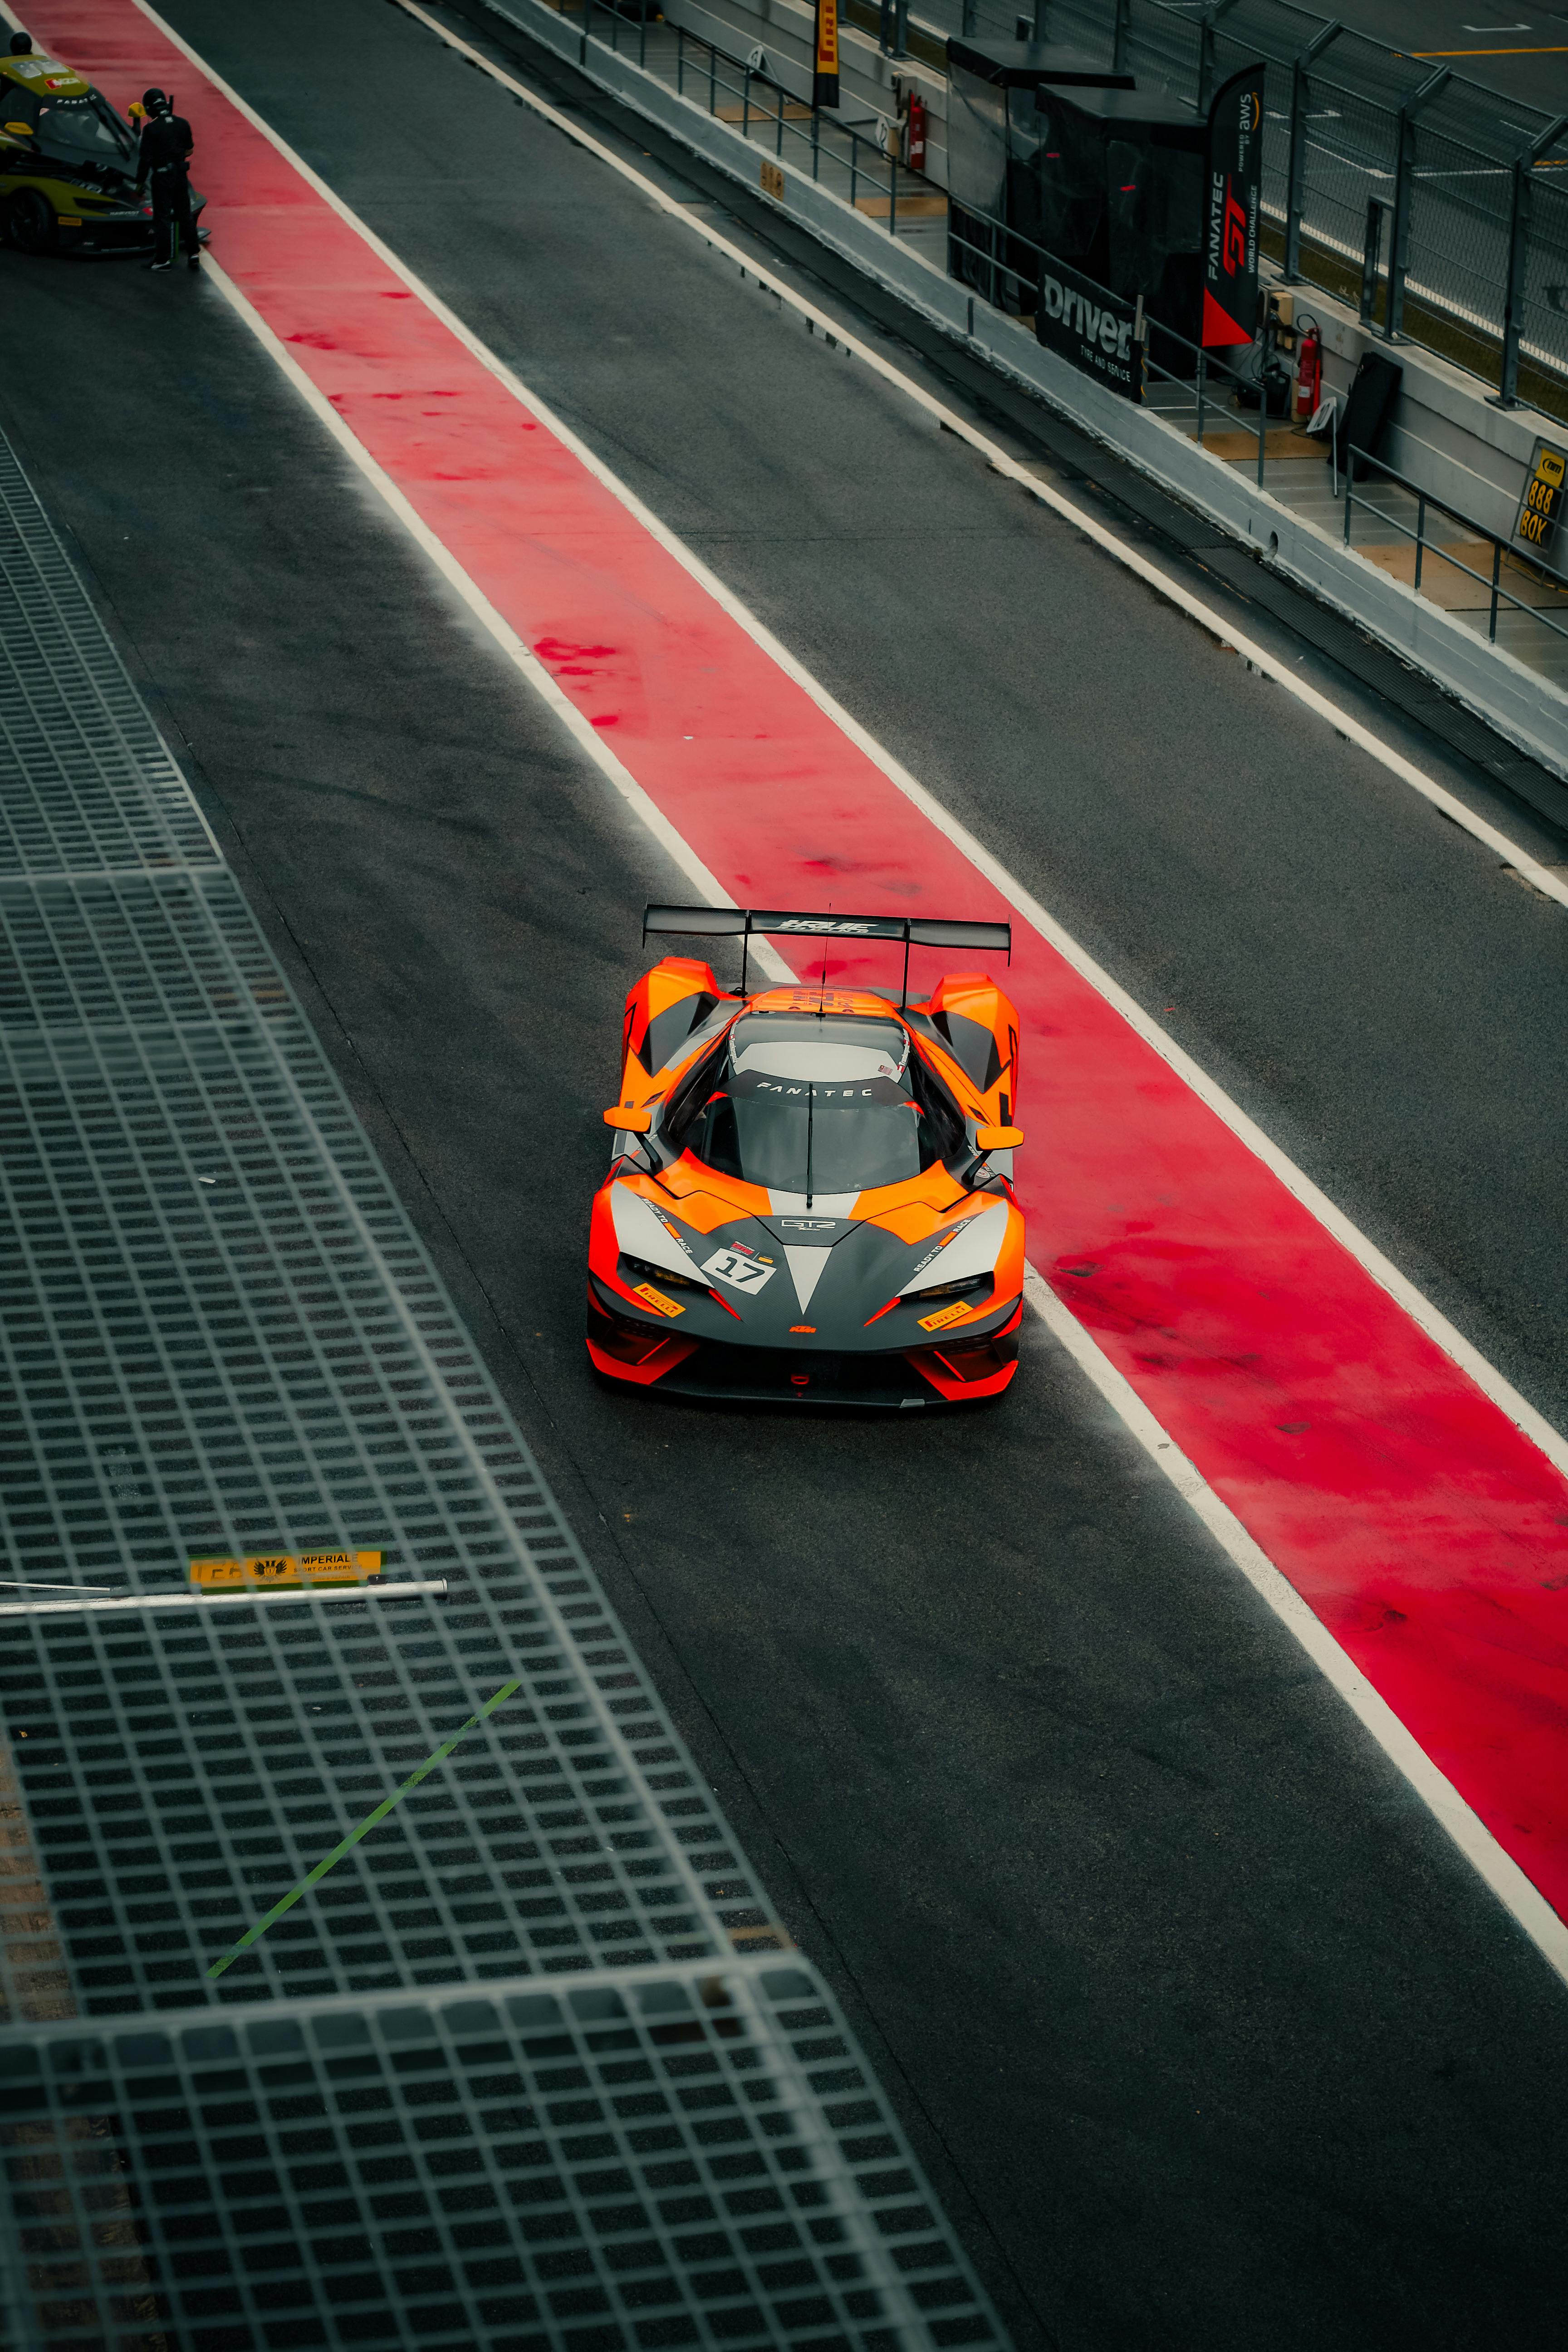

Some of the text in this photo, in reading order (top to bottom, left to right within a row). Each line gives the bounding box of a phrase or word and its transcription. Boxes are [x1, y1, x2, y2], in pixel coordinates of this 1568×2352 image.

[1240, 93, 1251, 131] aws
[1208, 172, 1224, 281] FANATEC
[1249, 185, 1257, 237] CHALLENGE
[1095, 355, 1106, 369] AND
[1107, 362, 1131, 382] SERVICE
[1529, 480, 1553, 514] 888
[1520, 510, 1547, 545] BOX
[756, 1082, 872, 1097] FANATEC
[642, 1198, 662, 1214] READY
[676, 1238, 693, 1254] RACE
[781, 1220, 835, 1229] GT2
[913, 1253, 935, 1272] READY
[953, 1219, 971, 1232] RACE
[715, 1256, 765, 1283] 17
[640, 1287, 678, 1313] PIRELLI
[925, 1305, 965, 1328] PIRELLI
